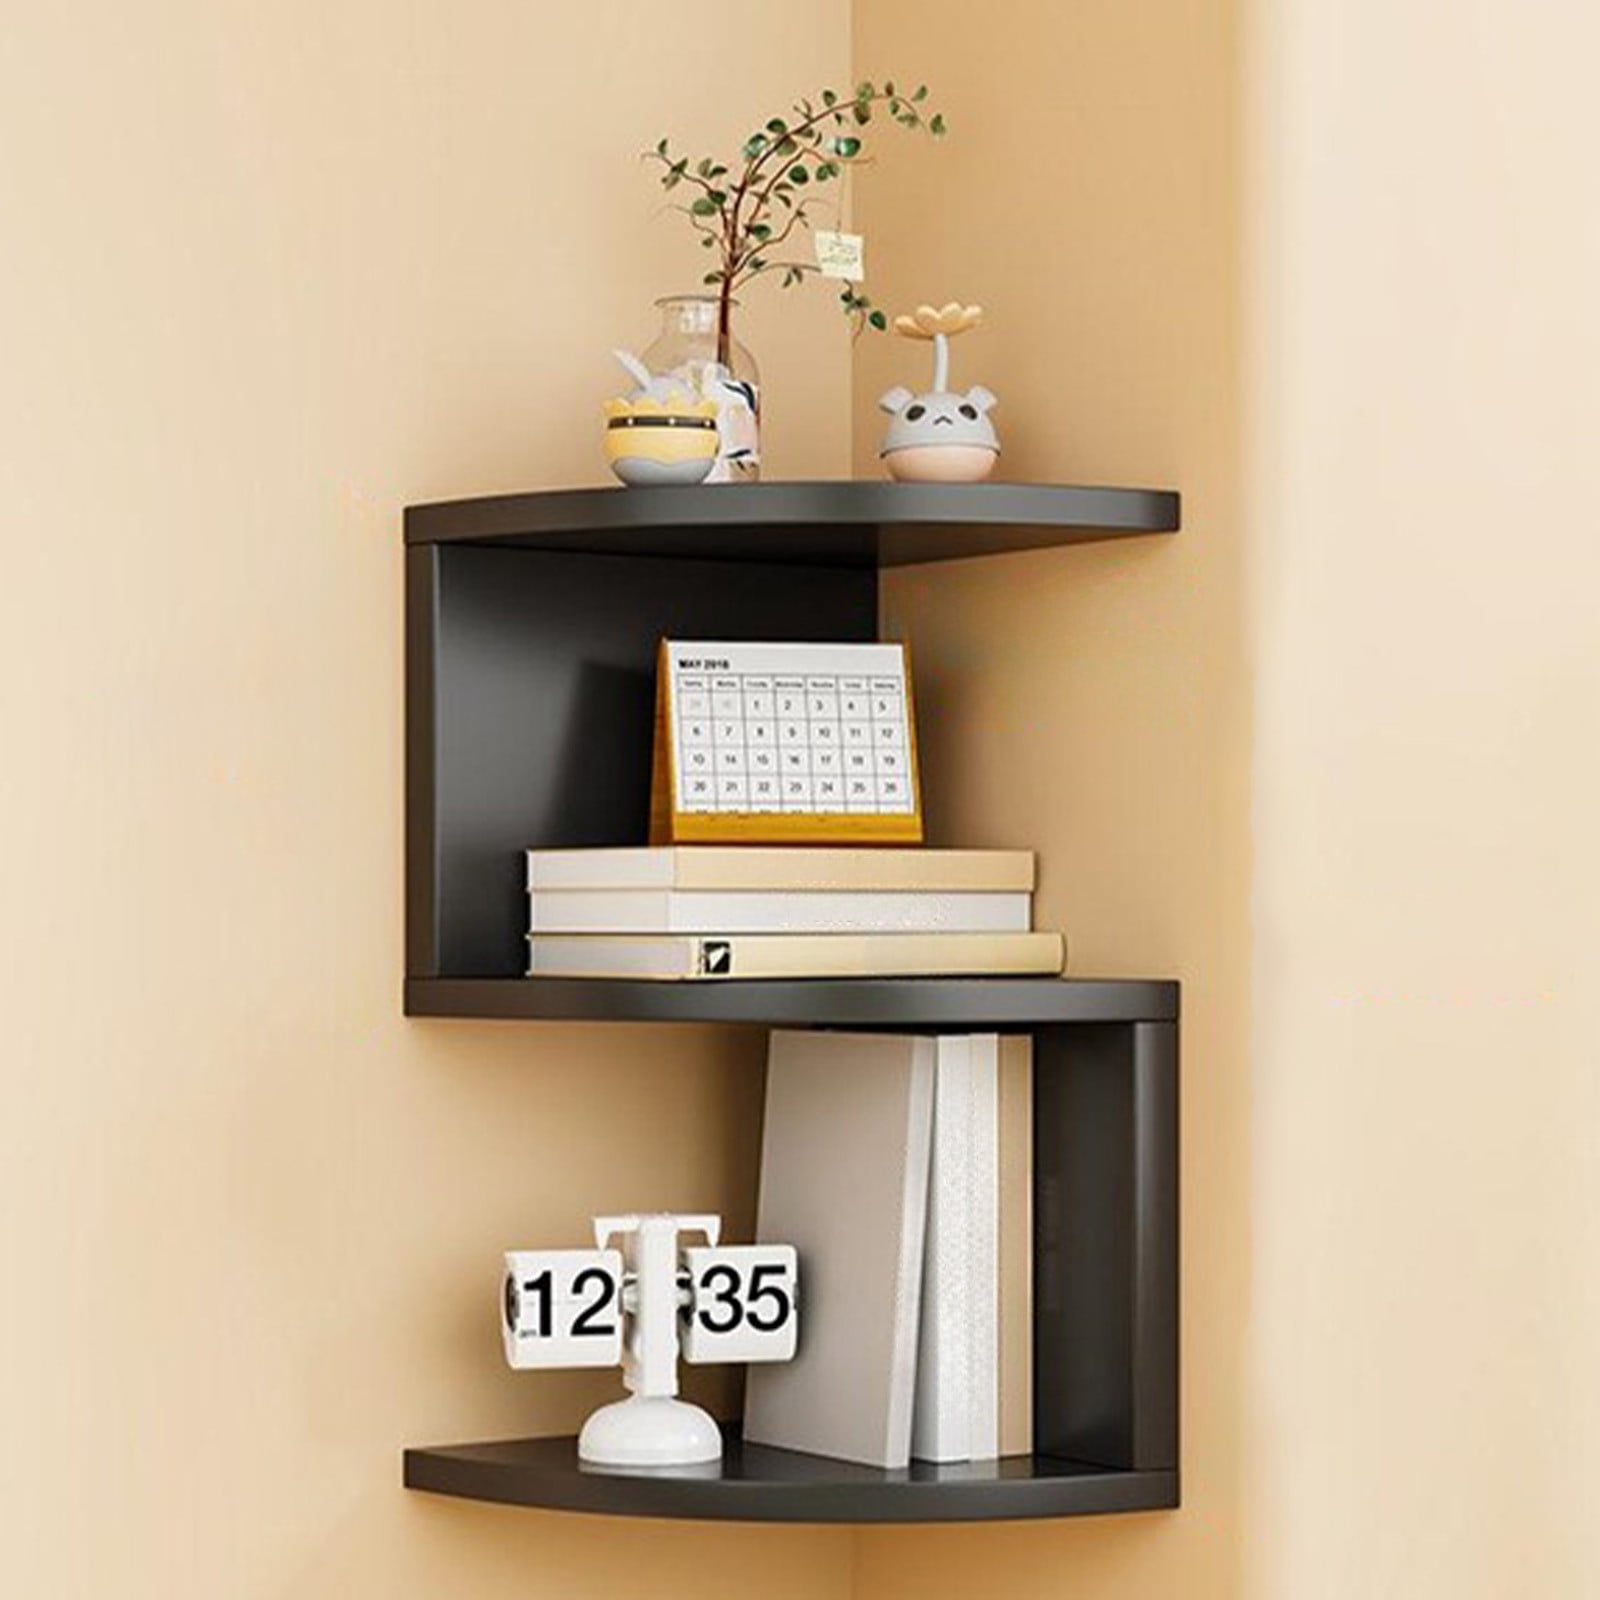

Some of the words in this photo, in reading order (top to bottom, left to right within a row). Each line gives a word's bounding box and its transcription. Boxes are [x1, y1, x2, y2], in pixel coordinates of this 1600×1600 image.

[678, 659, 701, 669] MAY
[704, 659, 729, 670] 2018
[784, 699, 792, 711] 2
[816, 699, 823, 711] 3
[847, 700, 855, 711] 4
[879, 700, 887, 711] 5
[692, 726, 701, 736] 6
[725, 726, 733, 737] 7
[757, 726, 764, 737] 8
[788, 727, 796, 738] 9
[819, 727, 831, 738] 10
[849, 727, 862, 738] 11
[881, 727, 894, 738] 12
[725, 754, 737, 765] 14
[757, 754, 770, 765] 15
[788, 754, 800, 765] 16
[820, 754, 832, 765] 17
[852, 754, 865, 765] 18
[883, 755, 896, 766] 19
[694, 781, 706, 792] 20
[725, 781, 738, 792] 21
[758, 781, 771, 792] 22
[789, 781, 803, 793] 23
[821, 781, 834, 793] 24
[853, 781, 866, 793] 25
[884, 781, 897, 793] 26
[523, 1268, 615, 1338] 12
[698, 1264, 790, 1333] 35
